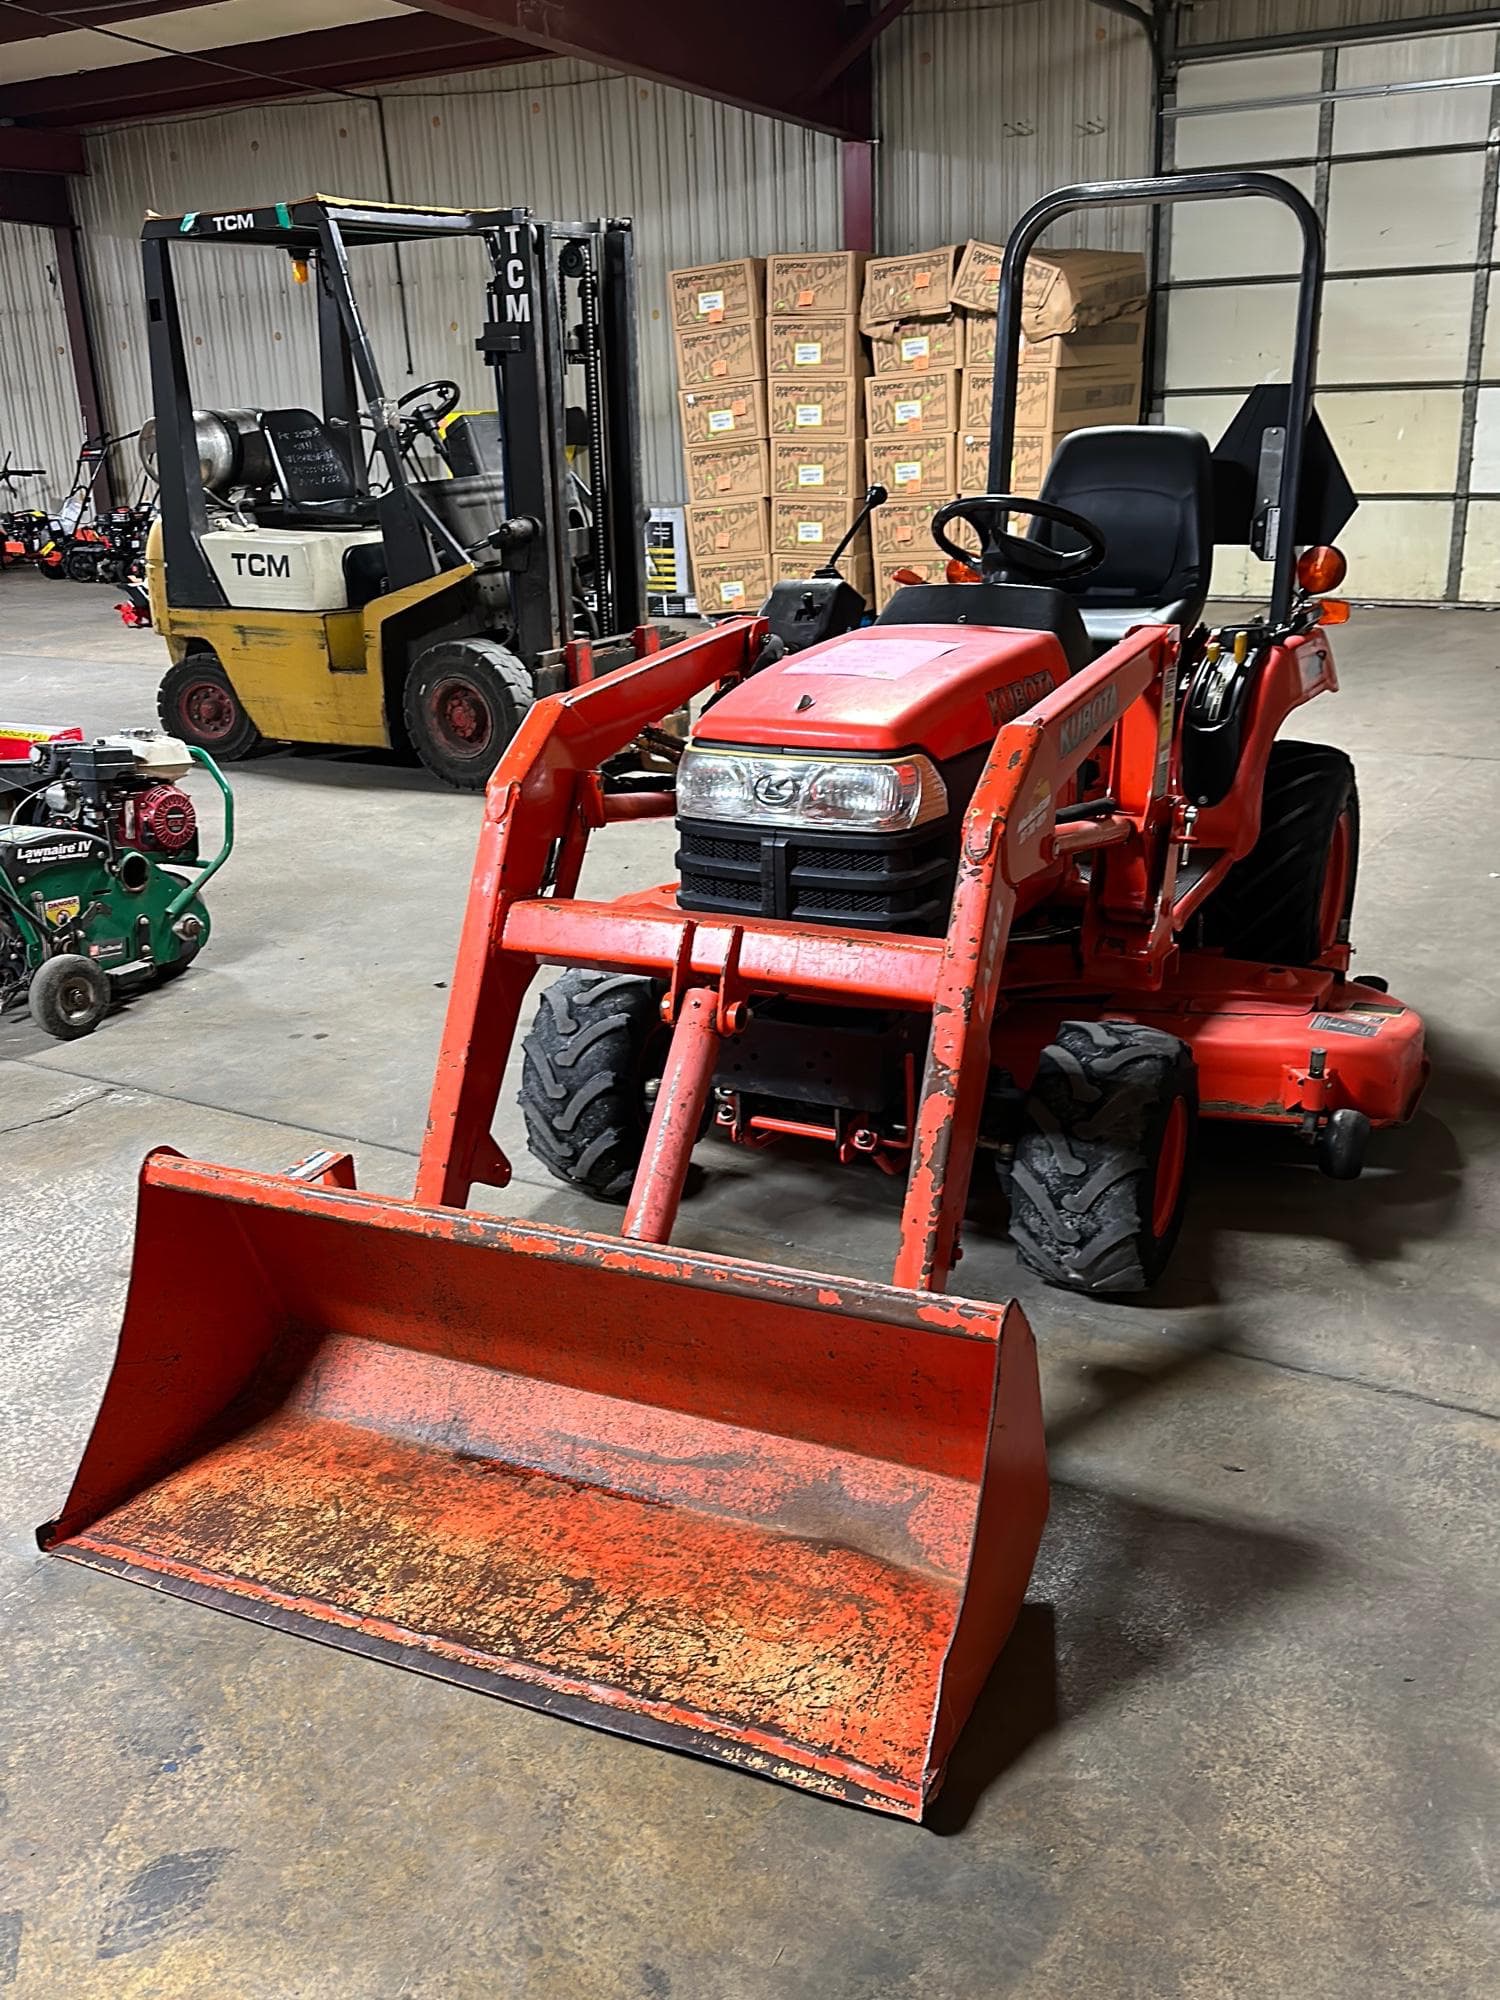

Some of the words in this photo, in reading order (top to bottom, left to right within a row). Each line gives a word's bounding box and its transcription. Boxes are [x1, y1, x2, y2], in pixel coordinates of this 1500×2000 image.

[212, 213, 254, 231] TCM
[776, 262, 807, 270] DIAMOND
[874, 265, 904, 276] DIAMOND
[504, 225, 530, 322] TCM
[676, 273, 705, 285] DIAMOND
[683, 334, 711, 345] DIAMOND
[874, 383, 904, 391] DIAMOND
[231, 553, 290, 578] TCM
[1060, 684, 1117, 758] KUBOTA
[16, 842, 77, 860] Lawnaire
[78, 840, 93, 852] IV
[48, 899, 78, 909] DANGER
